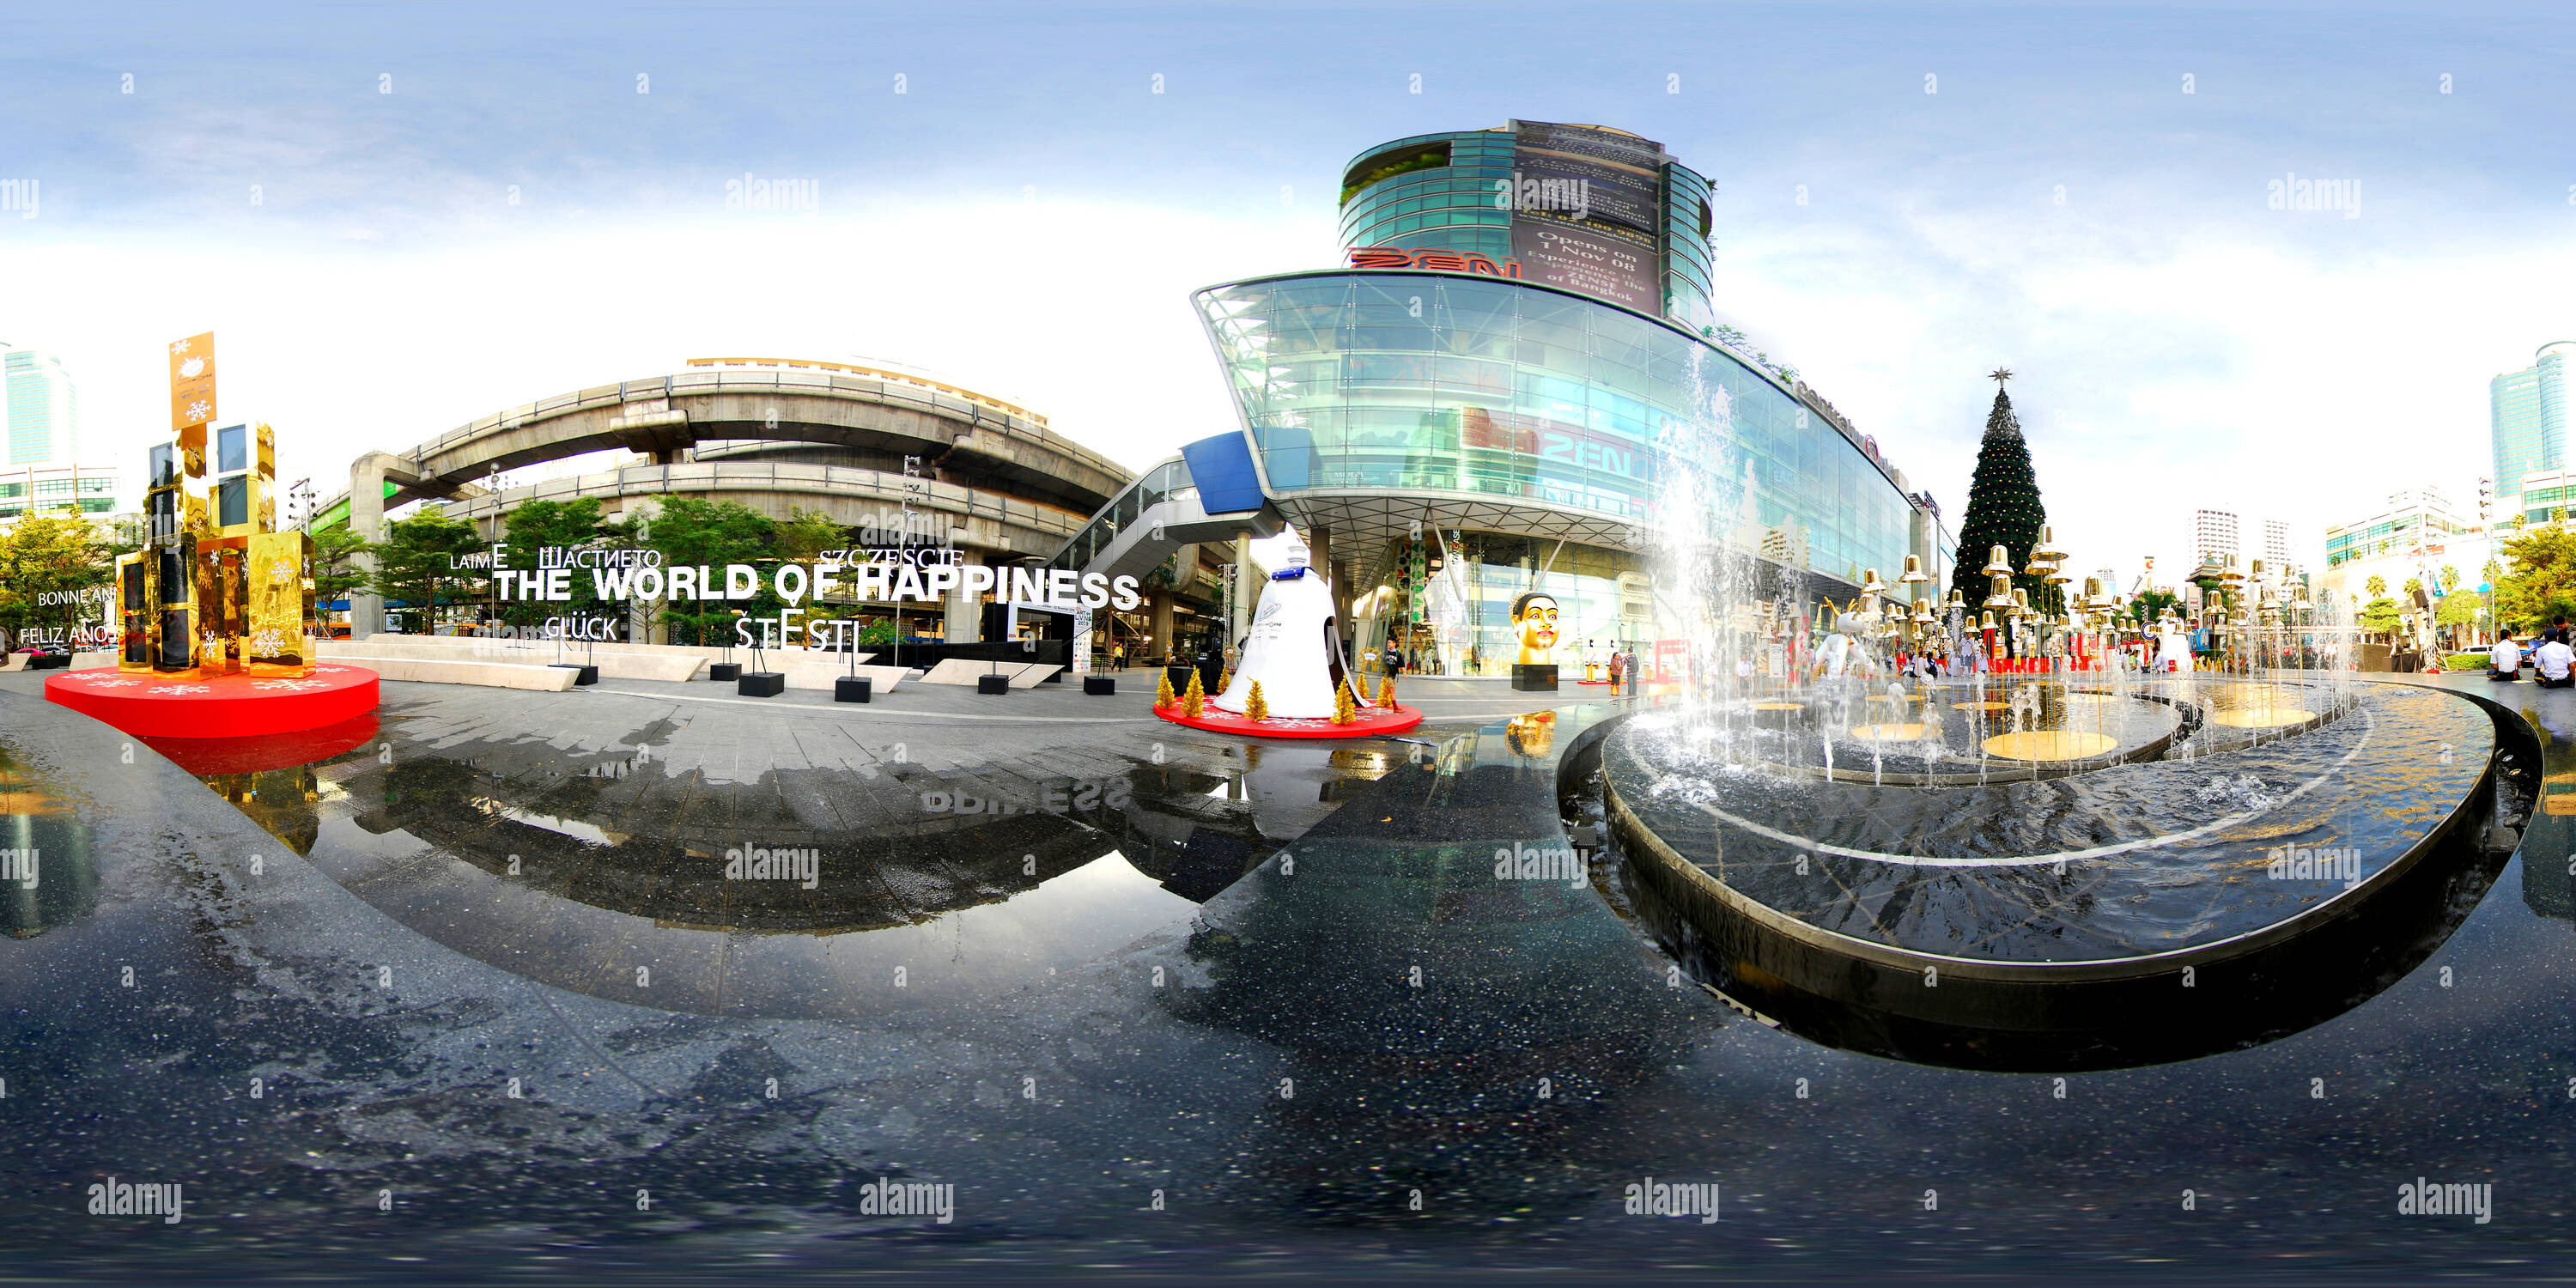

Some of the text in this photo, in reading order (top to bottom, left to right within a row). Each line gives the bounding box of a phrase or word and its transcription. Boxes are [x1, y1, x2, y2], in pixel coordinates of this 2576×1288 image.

[1585, 221, 1613, 232] 100
[1537, 231, 1637, 263] Opens on
[1562, 246, 1604, 262] Nov
[1612, 258, 1636, 272] 08
[1528, 250, 1616, 276] Experience
[1546, 274, 1634, 303] of Bangkok
[1567, 270, 1619, 289] ZENSE
[1543, 432, 1631, 476] ZEN
[38, 589, 88, 607] BONNE
[493, 563, 1139, 611] THE WORLD OF HAPPINESS
[20, 627, 64, 644] FELIZ
[69, 618, 108, 644] AÑO
[544, 611, 617, 641] GLÜCK
